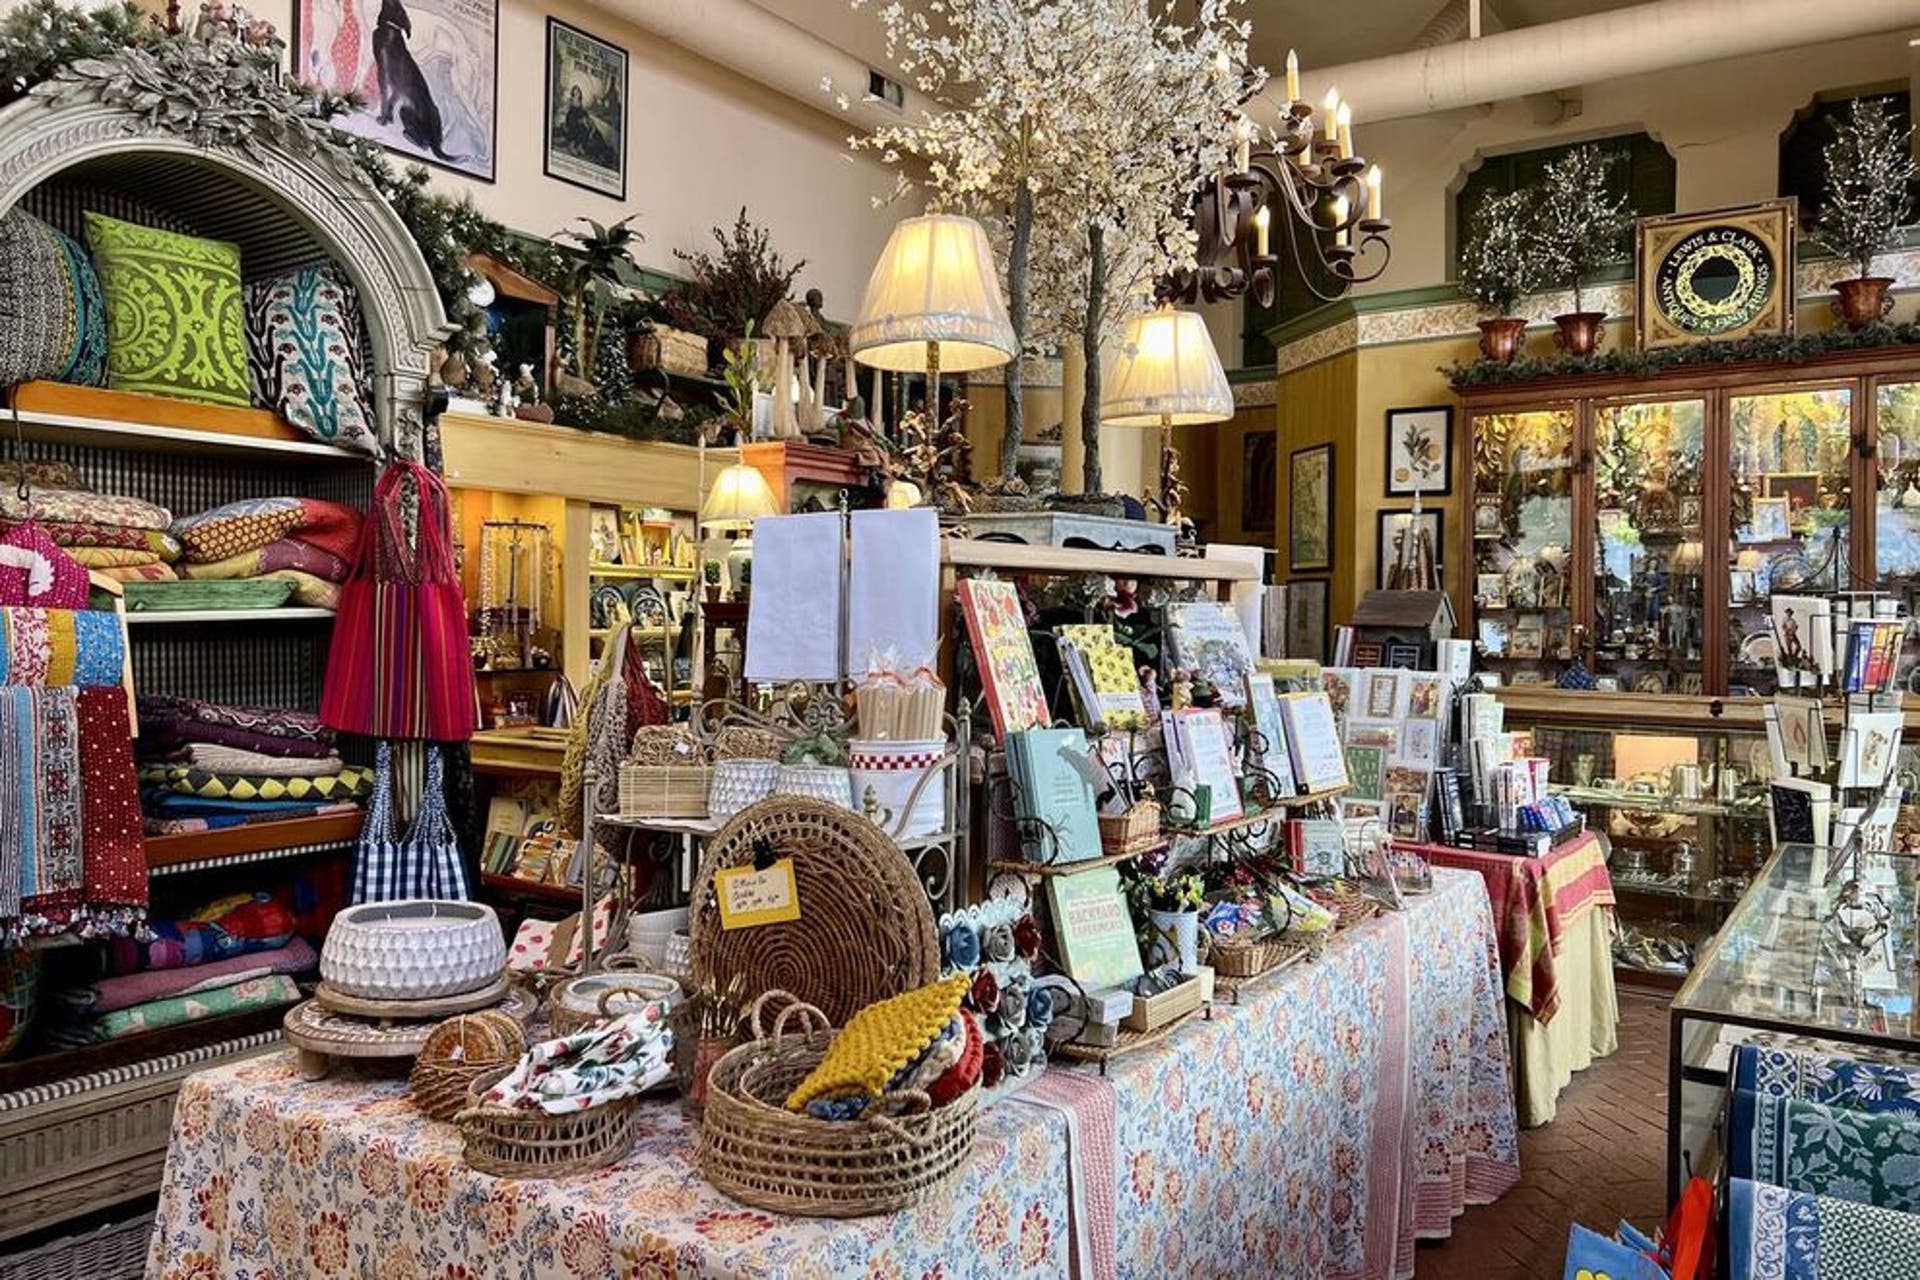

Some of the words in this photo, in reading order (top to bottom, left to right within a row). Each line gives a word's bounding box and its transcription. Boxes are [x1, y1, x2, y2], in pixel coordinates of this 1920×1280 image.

[1670, 235, 1705, 266] LEWIS
[1707, 231, 1719, 243] &
[1721, 231, 1762, 258] CLARK
[1662, 277, 1698, 327] ANTIQUES
